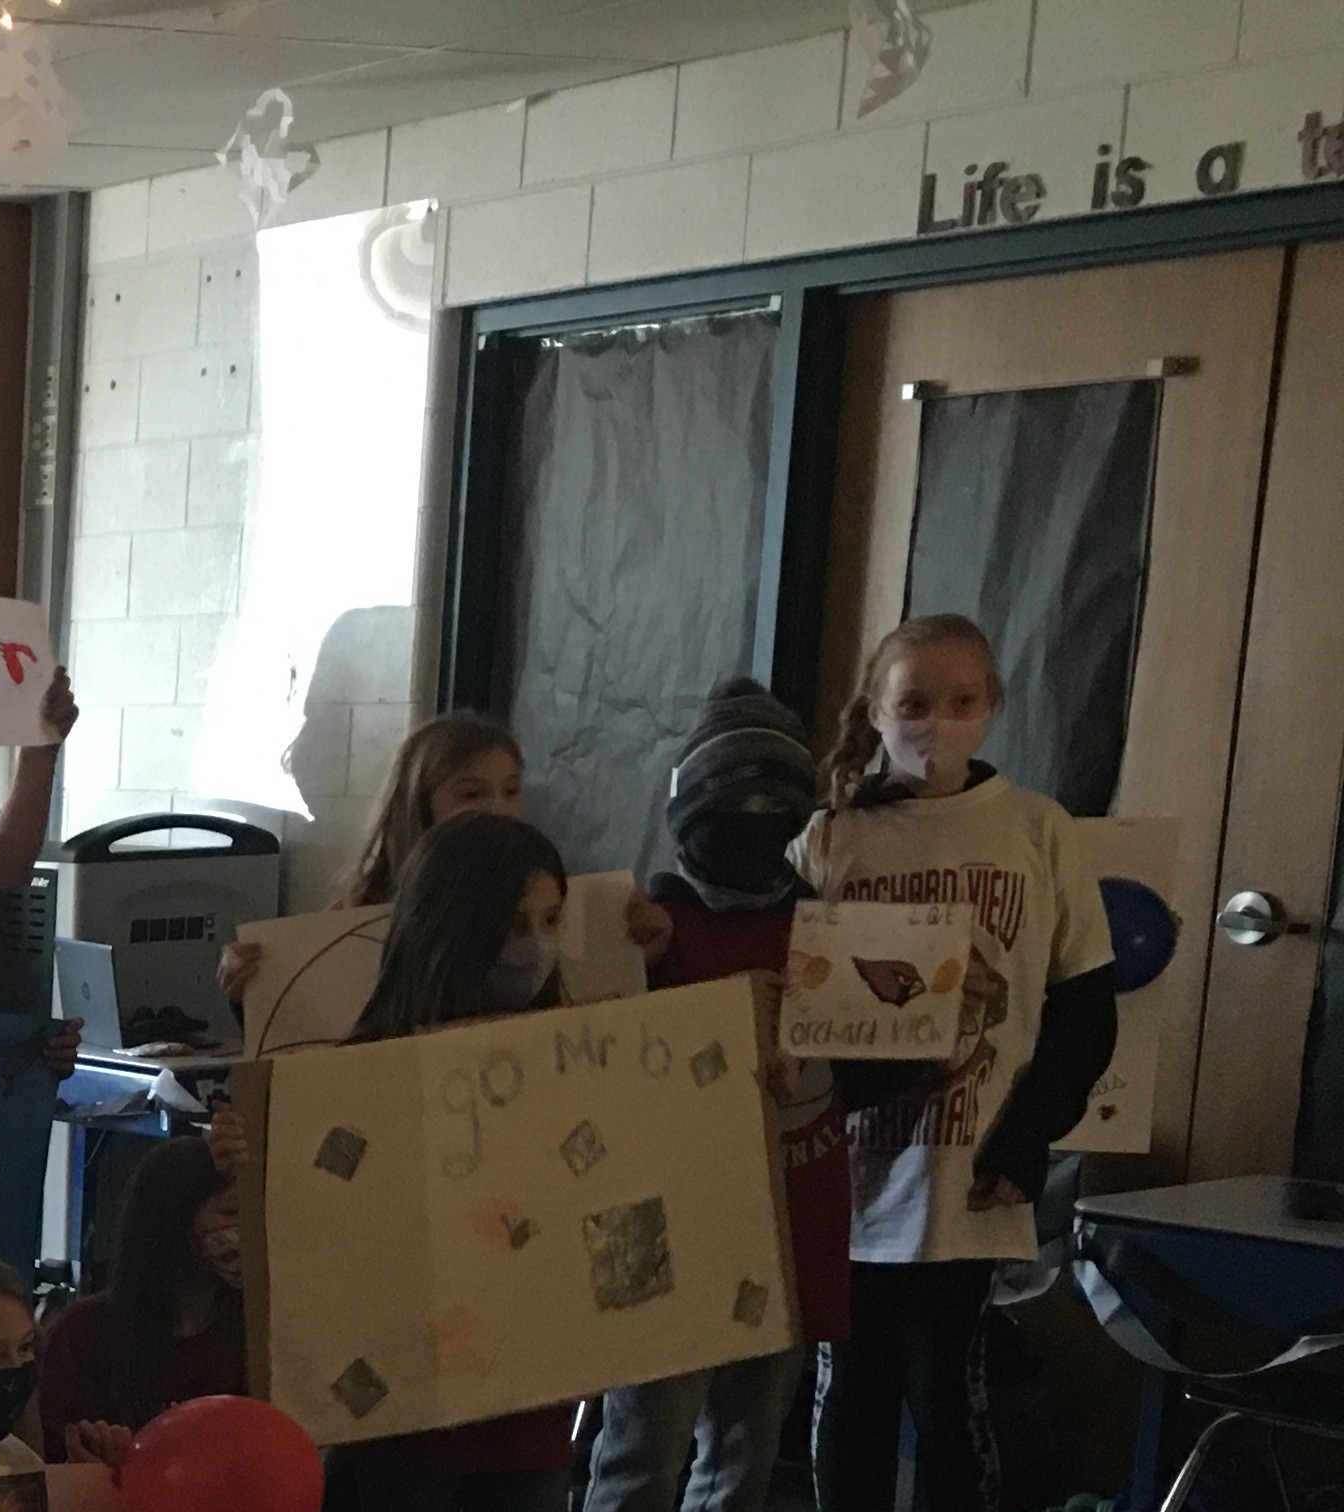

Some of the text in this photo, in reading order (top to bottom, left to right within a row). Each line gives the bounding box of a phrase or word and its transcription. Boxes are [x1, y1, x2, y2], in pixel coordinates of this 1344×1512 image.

[916, 160, 1048, 236] Life
[1090, 142, 1154, 210] is
[1195, 139, 1249, 196] a
[440, 1049, 525, 1180] go
[557, 1023, 616, 1074] Mr
